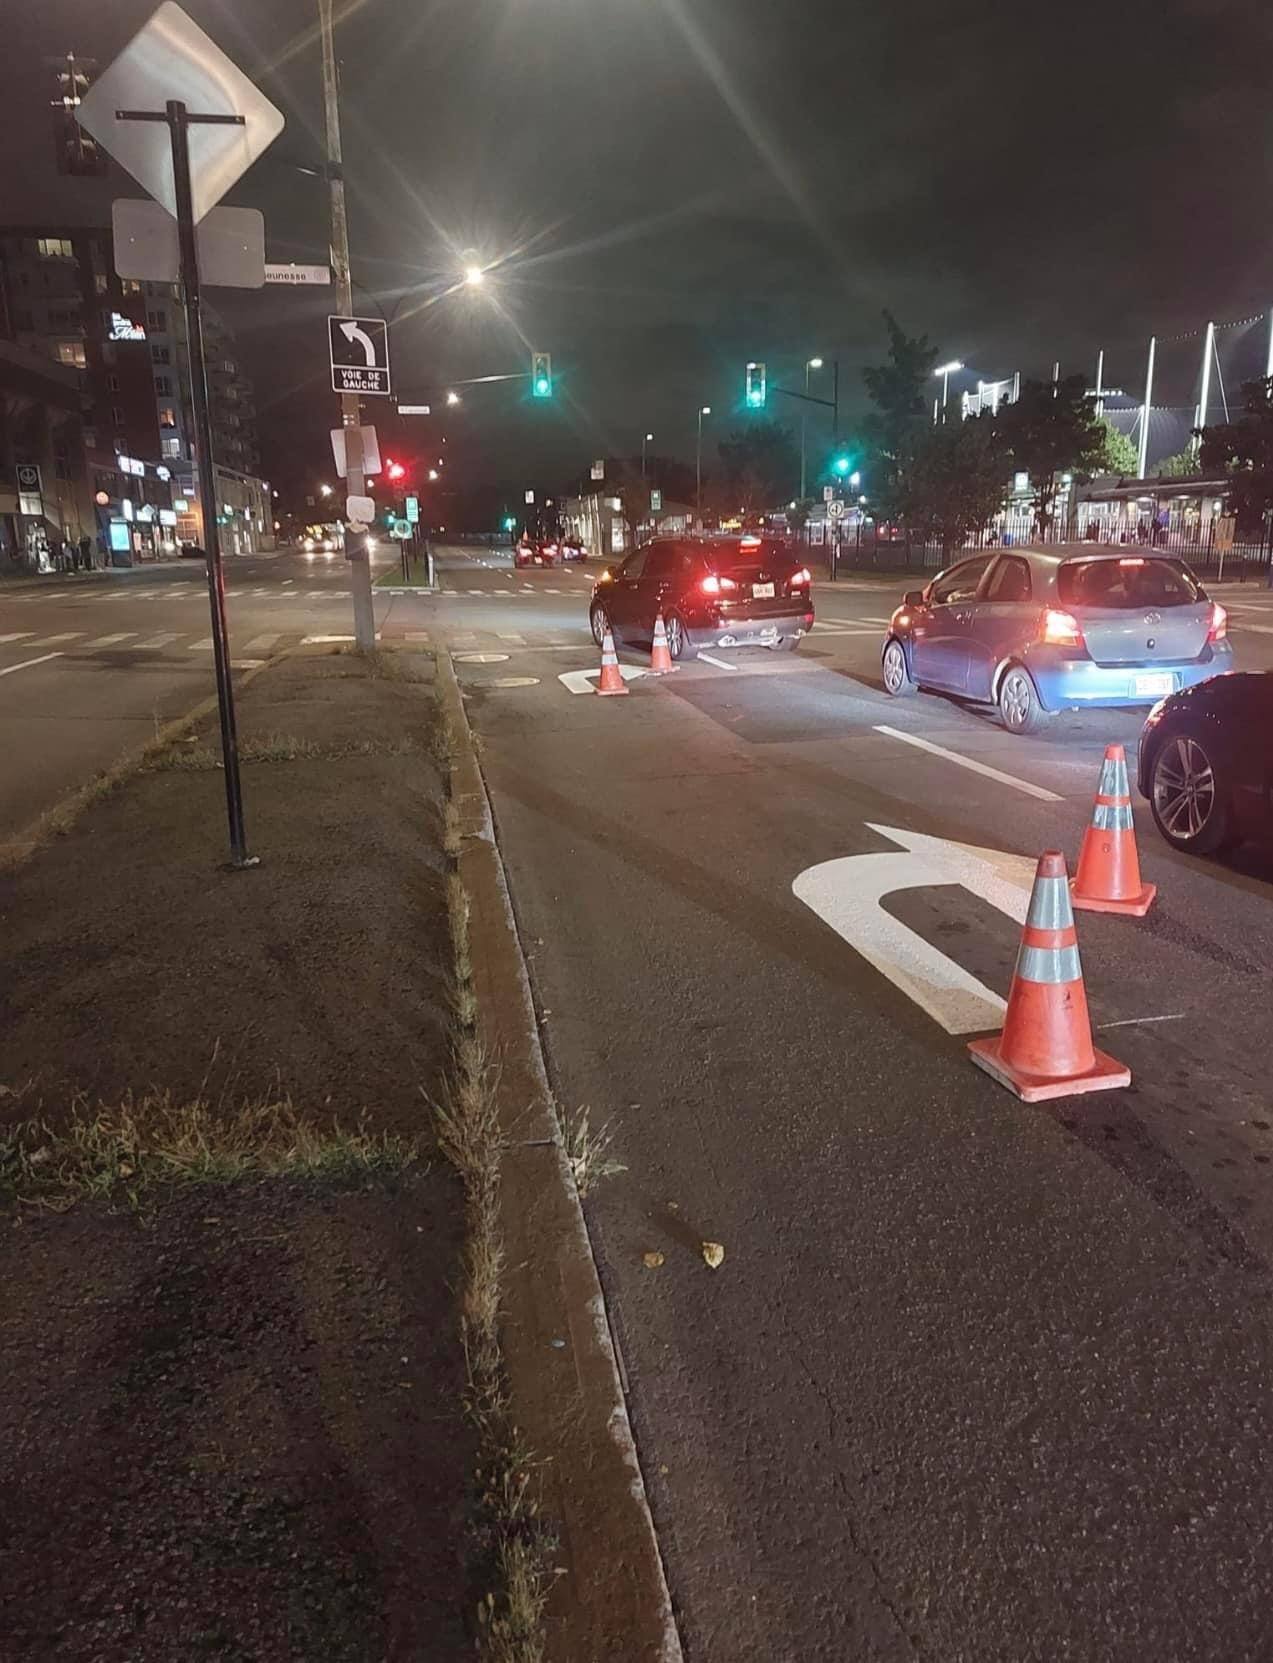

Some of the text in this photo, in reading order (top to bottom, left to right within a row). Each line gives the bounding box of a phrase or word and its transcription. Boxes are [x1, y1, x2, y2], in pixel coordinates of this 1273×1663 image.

[264, 272, 306, 281] eunesse
[341, 369, 380, 381] VOIE DE
[342, 379, 380, 390] GAUCHE
